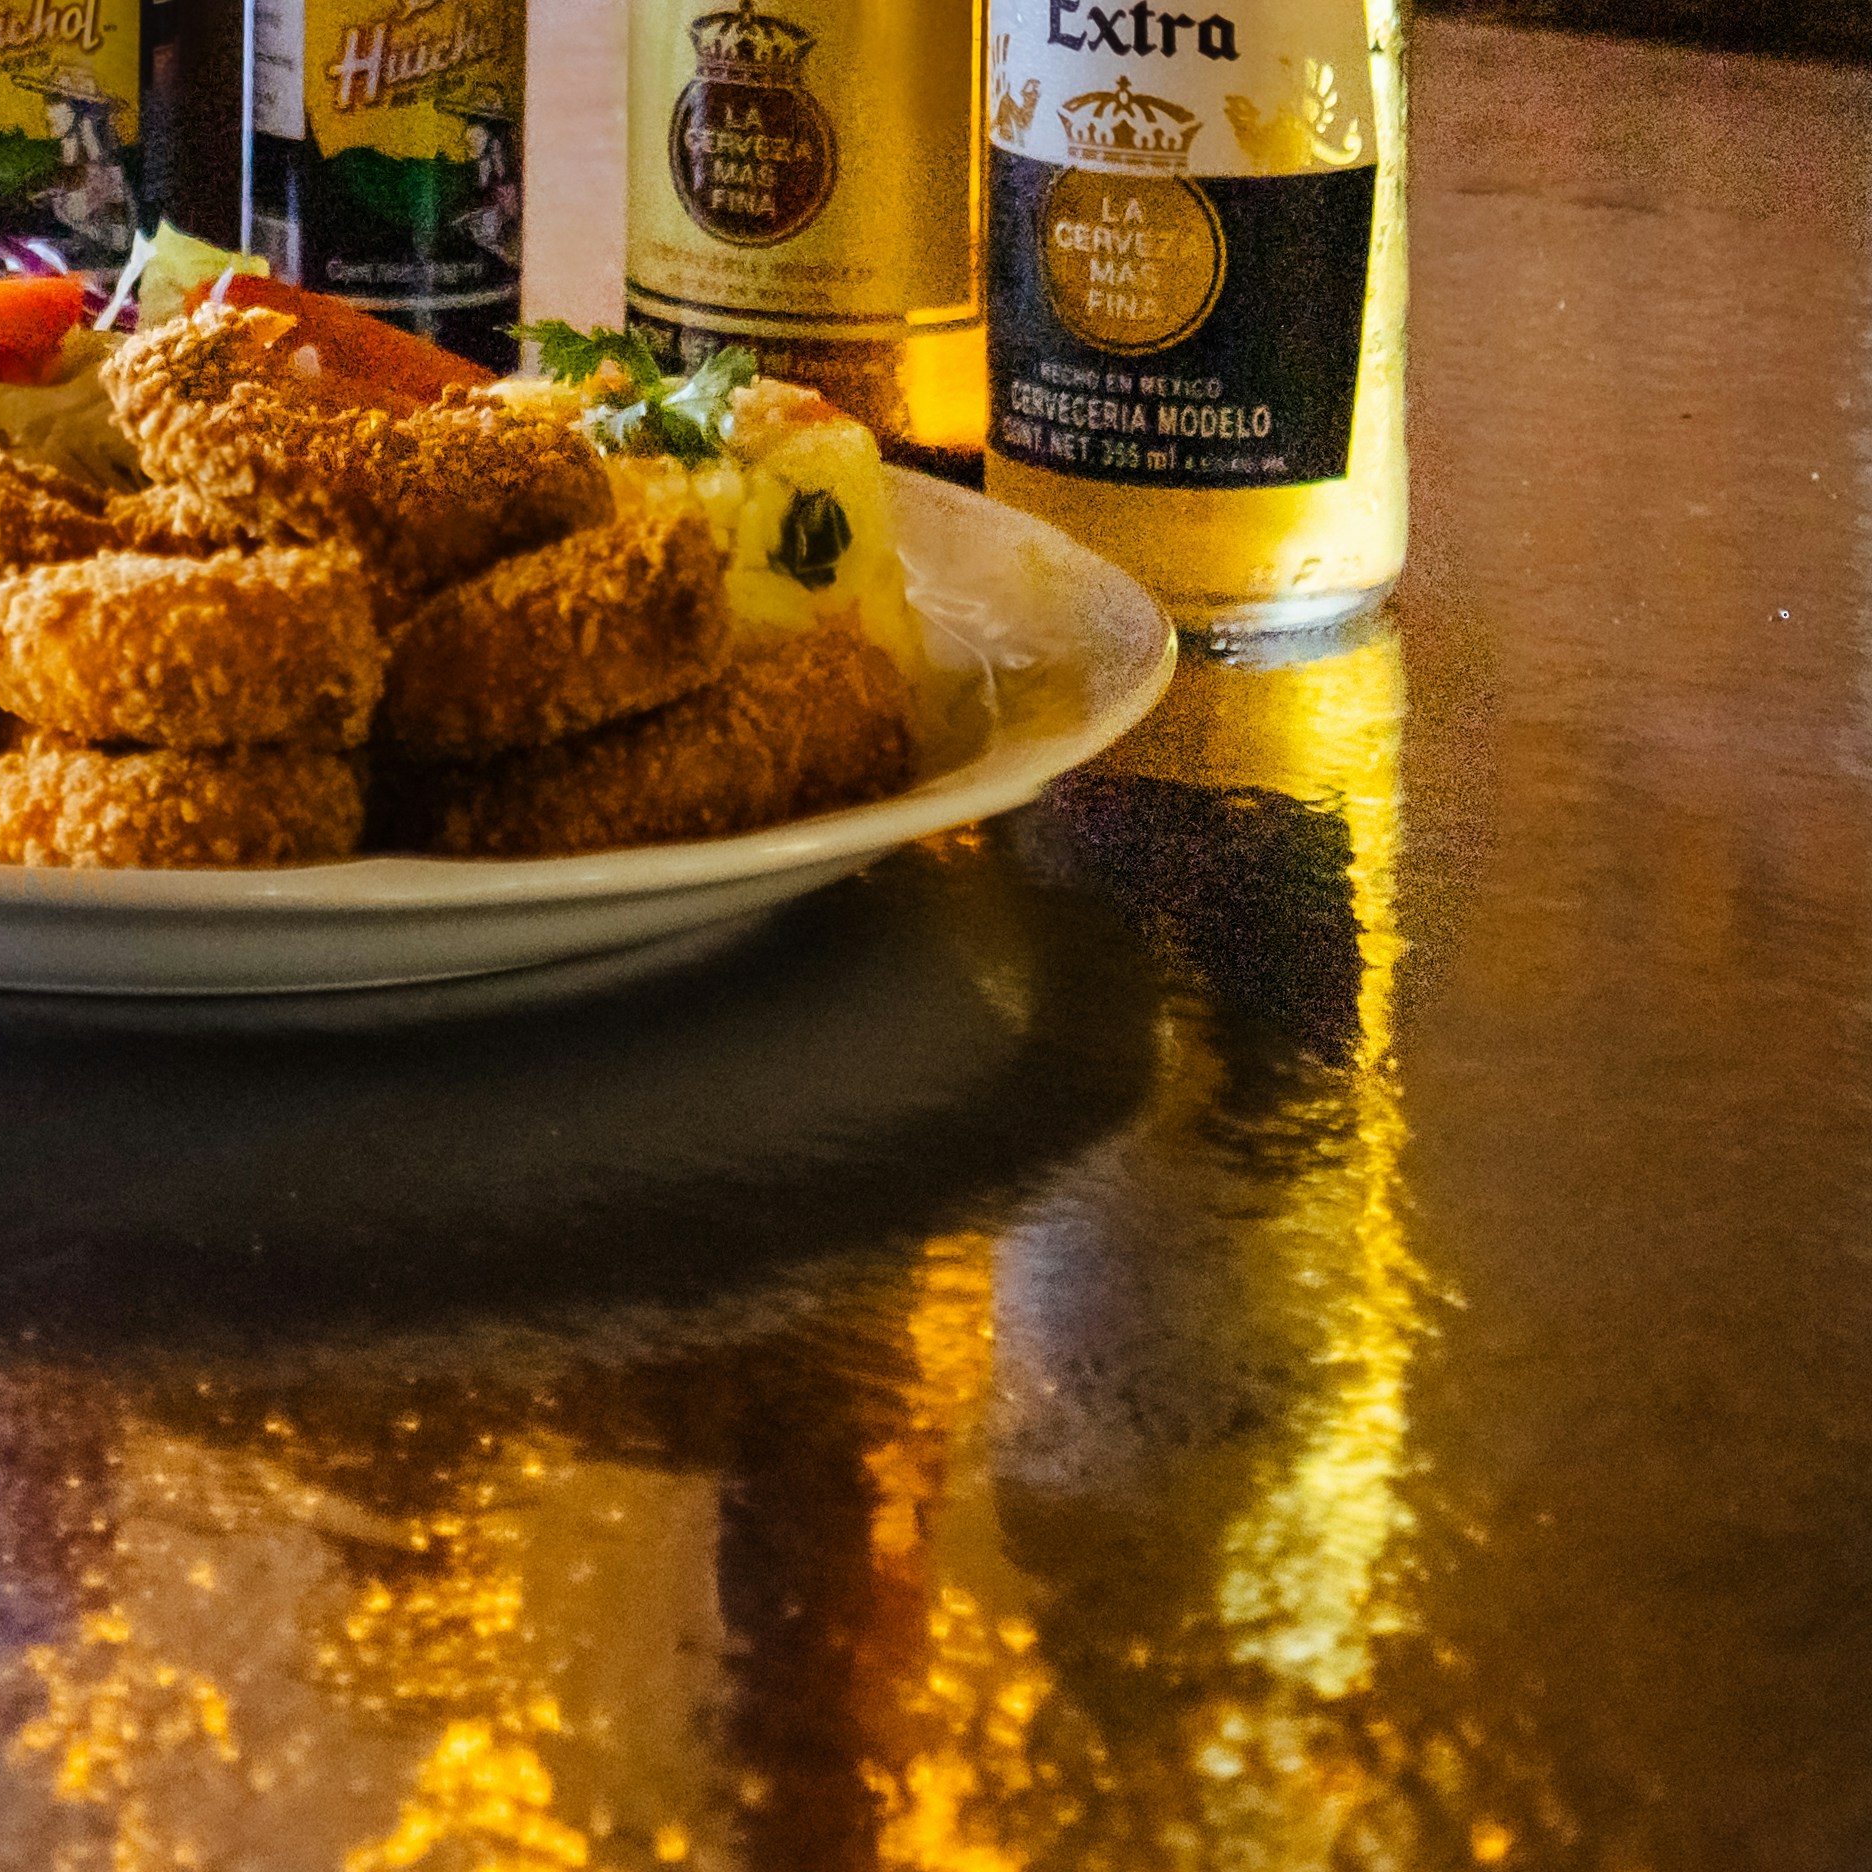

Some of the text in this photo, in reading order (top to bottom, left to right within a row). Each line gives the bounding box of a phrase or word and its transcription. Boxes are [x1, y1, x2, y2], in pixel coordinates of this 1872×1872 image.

[724, 103, 762, 129] LA
[684, 126, 813, 163] CERVEZA
[713, 159, 776, 189] MAS
[711, 188, 776, 219] FINA
[1102, 196, 1144, 224] LA
[1055, 220, 1197, 262] CERVEZ
[1090, 257, 1158, 289] MAS
[1105, 373, 1133, 395] EN
[1010, 379, 1273, 440] CERVECERIA MODELO
